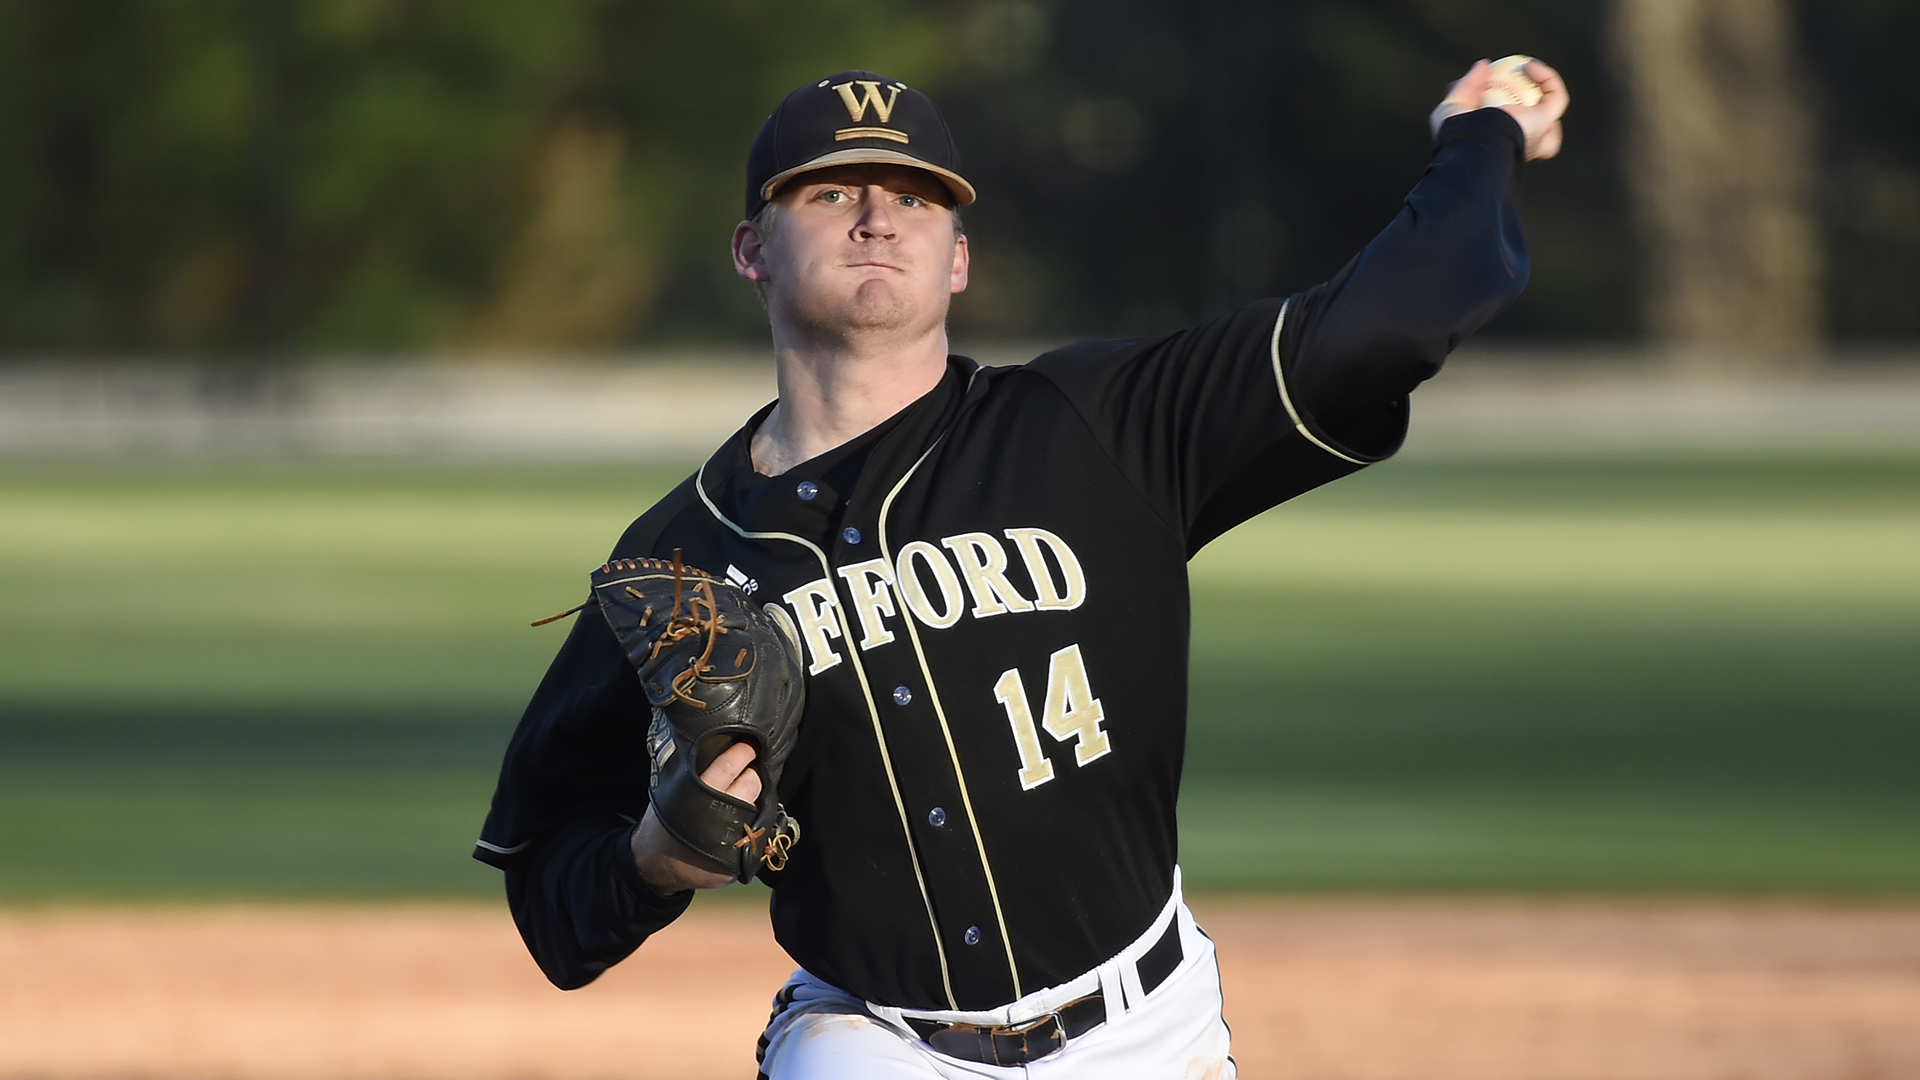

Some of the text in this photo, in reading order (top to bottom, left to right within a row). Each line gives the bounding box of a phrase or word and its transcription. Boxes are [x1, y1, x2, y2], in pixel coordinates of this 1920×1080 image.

[831, 80, 901, 123] W
[762, 527, 1087, 676] FFORD
[993, 643, 1112, 792] 14
